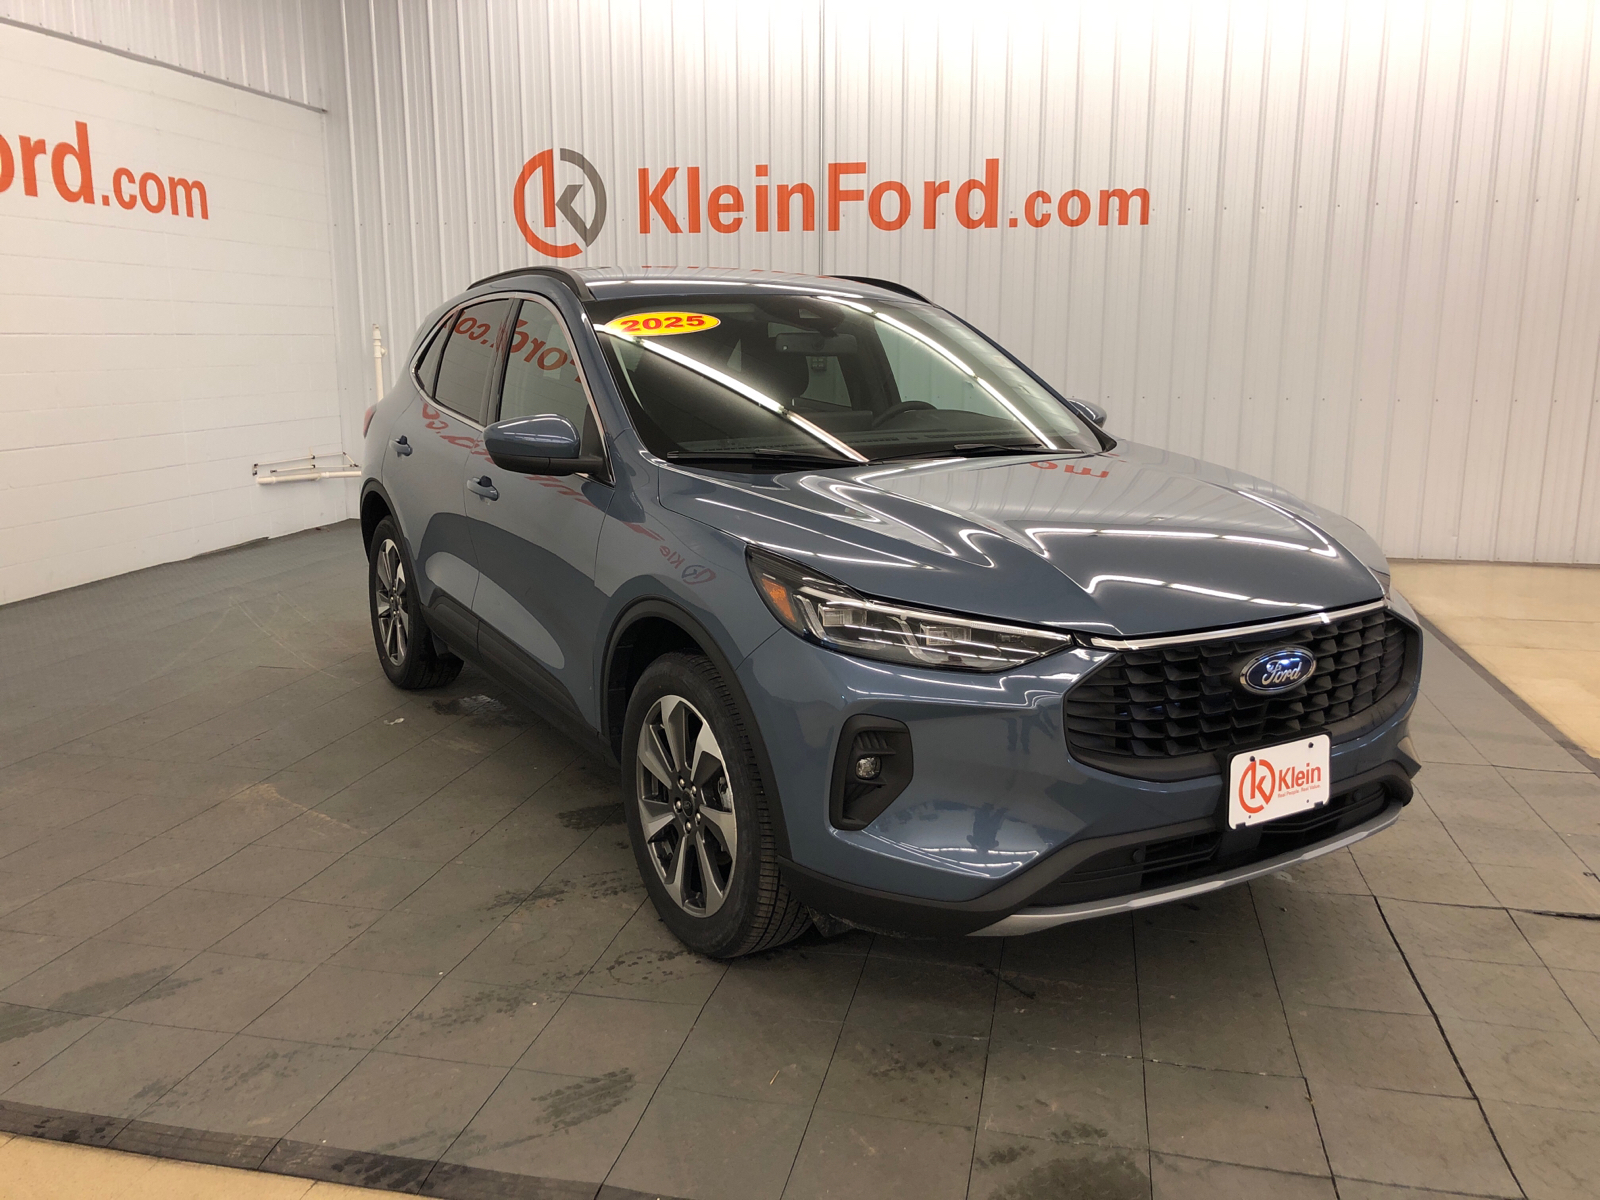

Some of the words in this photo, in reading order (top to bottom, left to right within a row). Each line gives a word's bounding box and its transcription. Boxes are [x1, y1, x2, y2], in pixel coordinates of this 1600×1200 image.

[638, 158, 1150, 234] KleinFord.com
[620, 315, 705, 332] 2025
[1262, 659, 1302, 685] Ford
[1278, 763, 1321, 792] Klein
